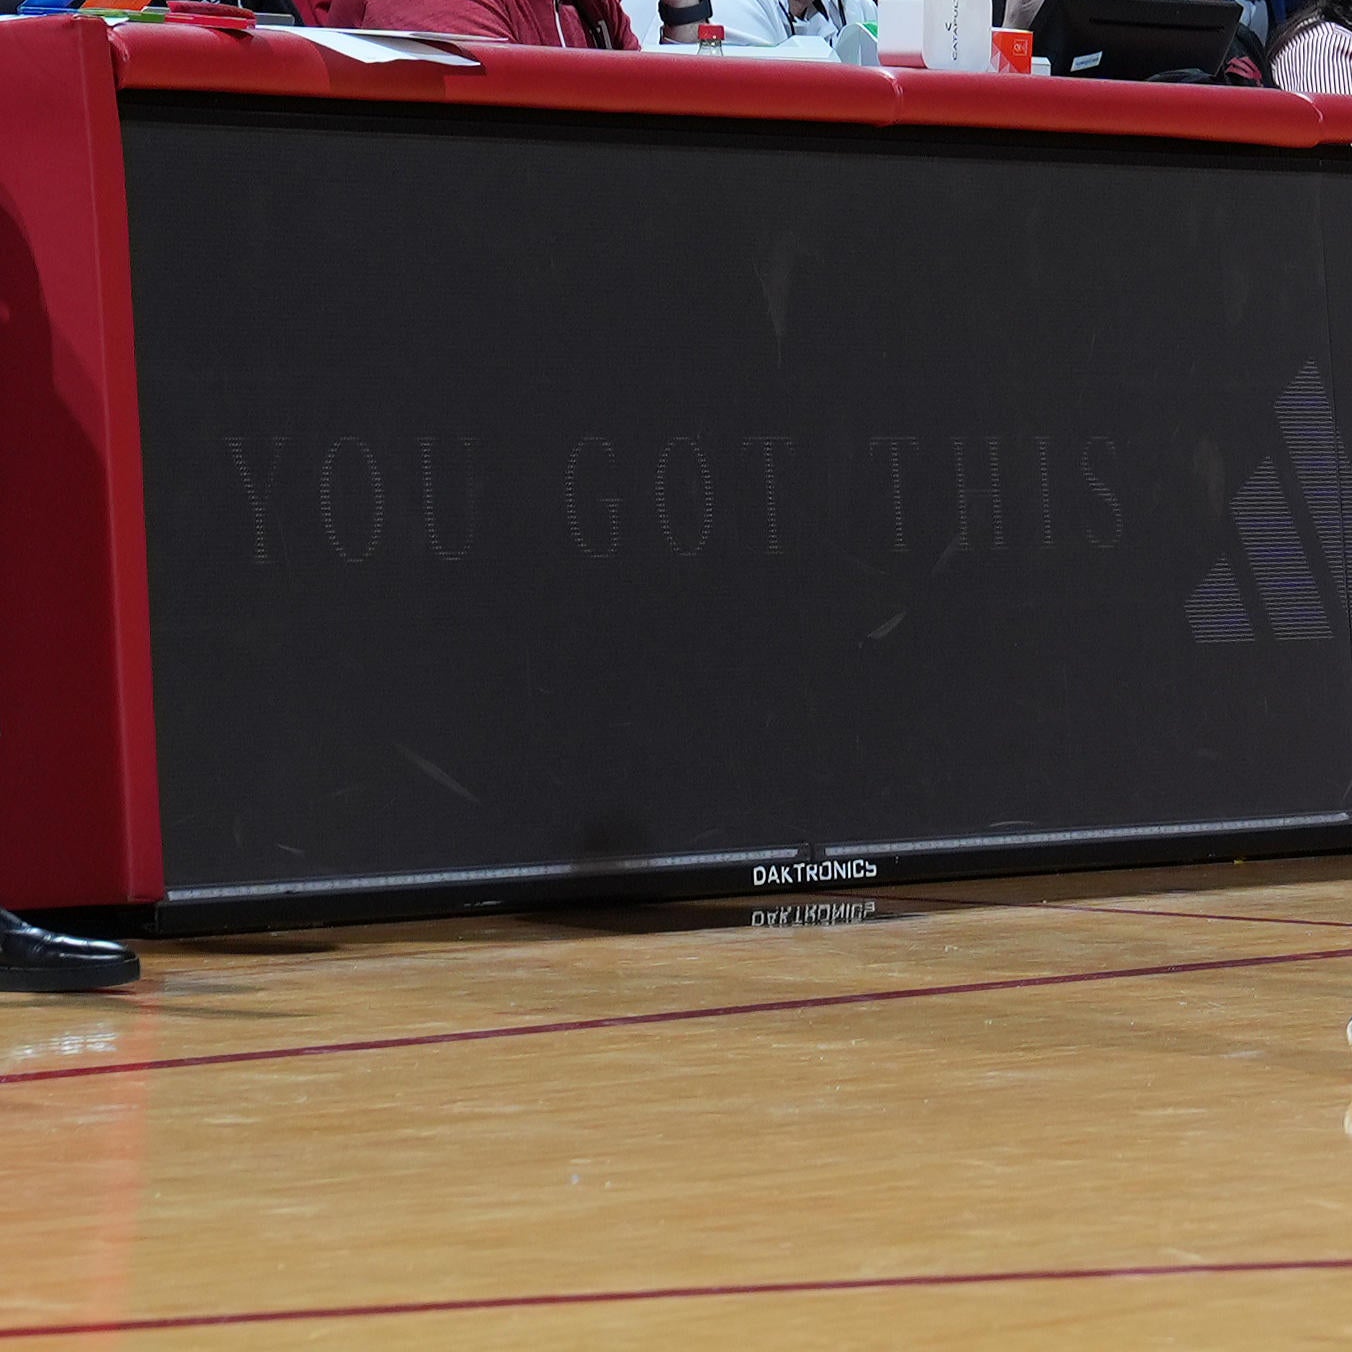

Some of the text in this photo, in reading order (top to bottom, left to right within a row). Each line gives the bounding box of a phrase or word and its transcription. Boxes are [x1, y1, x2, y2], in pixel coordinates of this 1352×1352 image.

[224, 434, 1127, 565] YOU GOT THIS
[753, 859, 877, 886] DAKTRONICS
